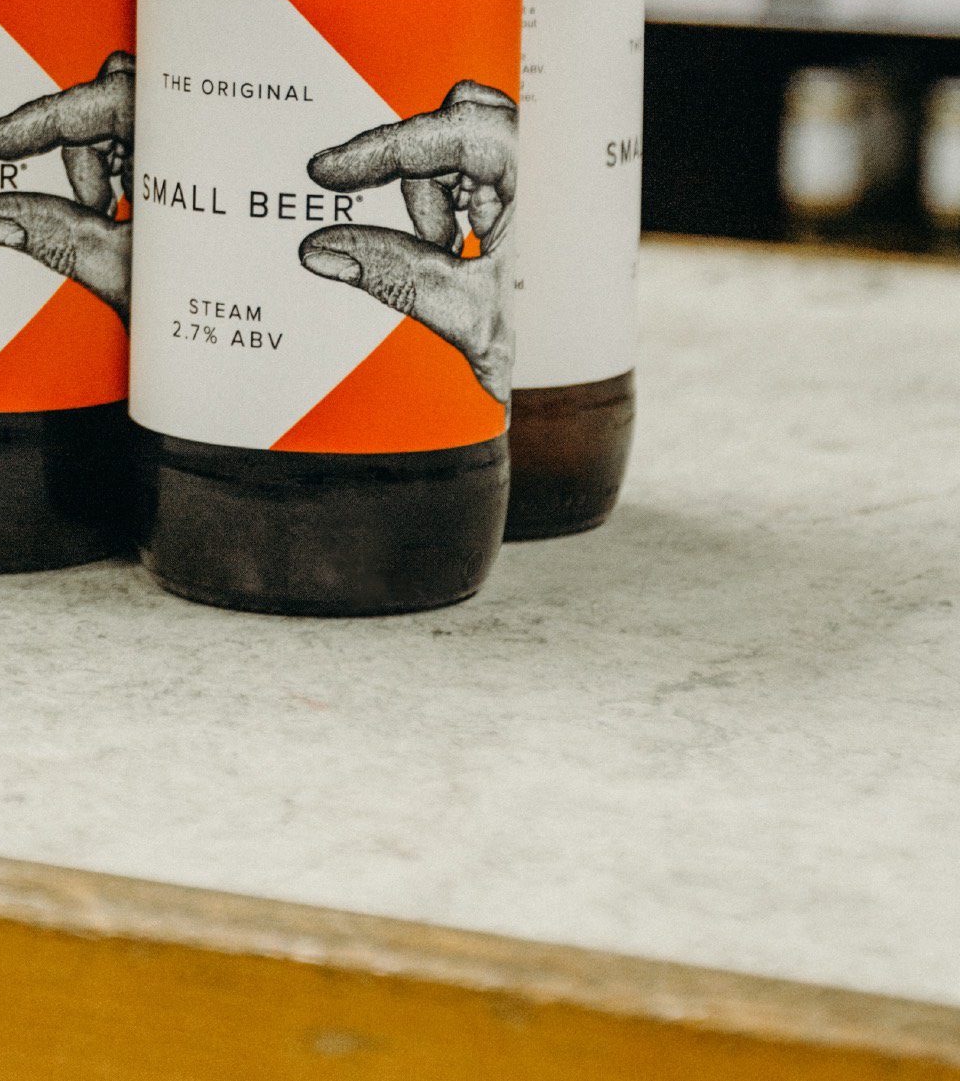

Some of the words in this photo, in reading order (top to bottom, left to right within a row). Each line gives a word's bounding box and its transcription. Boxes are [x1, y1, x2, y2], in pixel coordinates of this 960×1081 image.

[162, 72, 192, 93] THE
[201, 78, 314, 102] ORIGINAL
[606, 136, 643, 168] SMA
[142, 173, 227, 215] SMALL
[189, 298, 262, 322] STEAM
[172, 319, 218, 345] 2.7%
[230, 329, 283, 350] ABV
